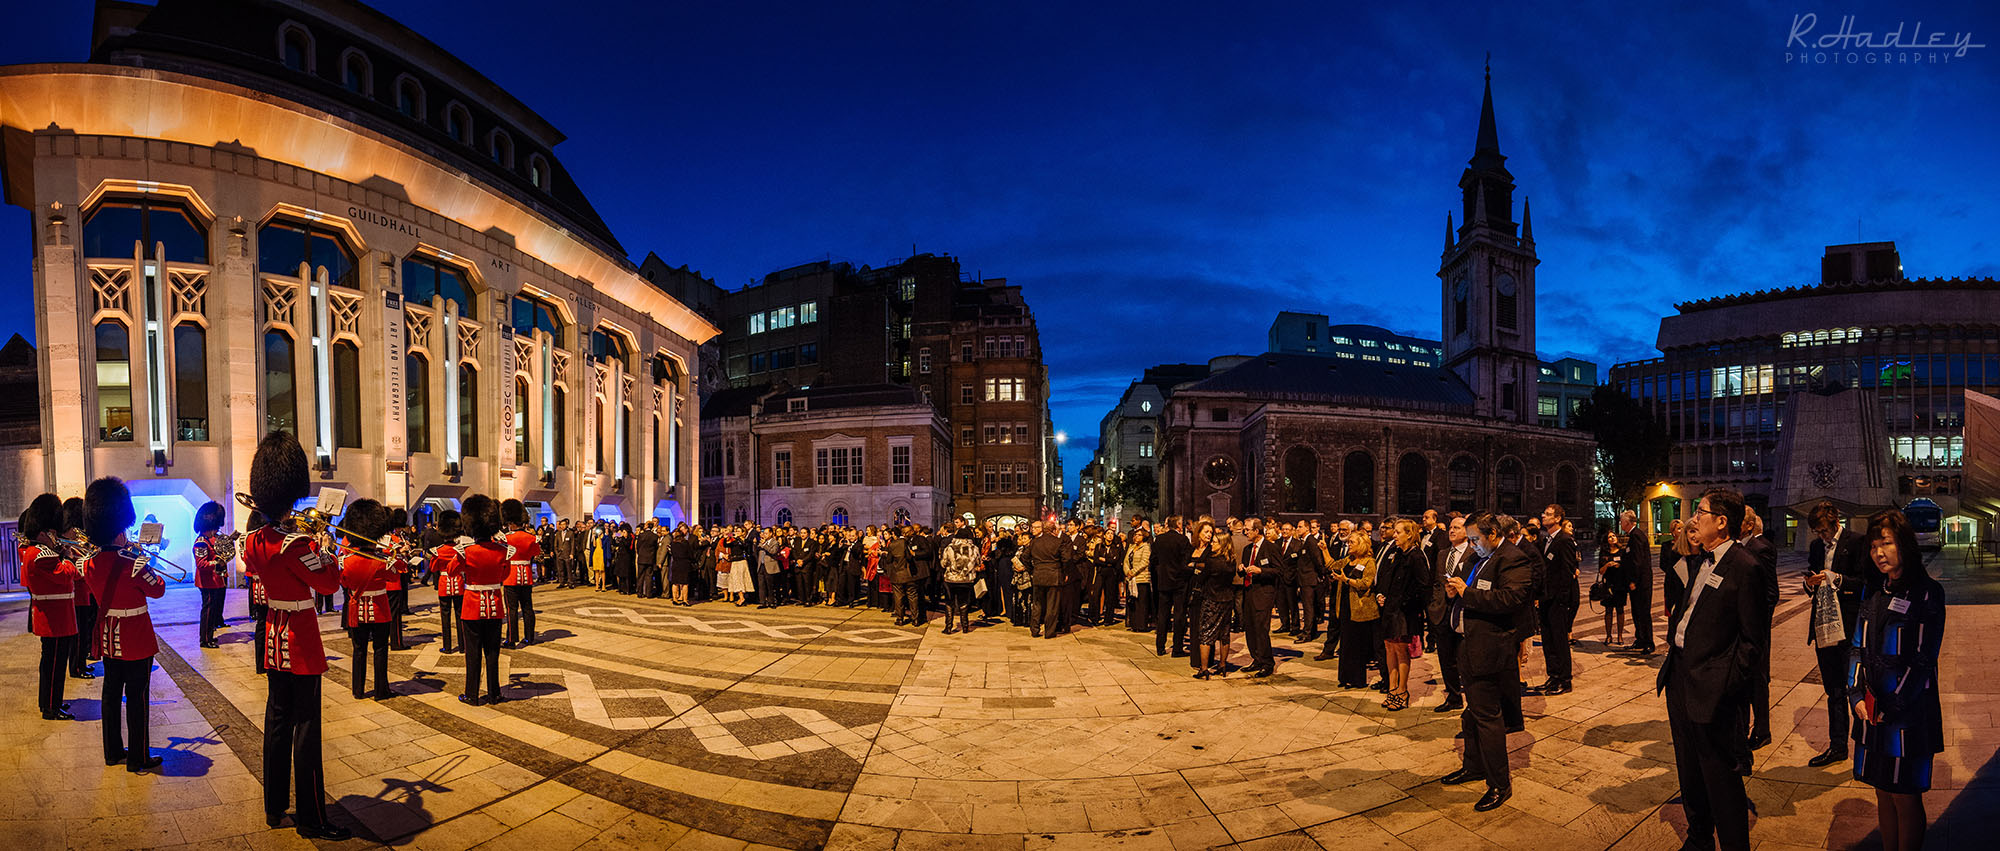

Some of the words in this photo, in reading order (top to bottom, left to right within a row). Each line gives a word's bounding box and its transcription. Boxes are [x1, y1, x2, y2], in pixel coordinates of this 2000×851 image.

[347, 206, 422, 239] GUILDHALL
[491, 258, 511, 273] ART
[568, 292, 601, 313] GALLERY
[389, 321, 398, 339] ART
[390, 343, 399, 361] AND
[391, 366, 400, 422] TELEGRAPHY
